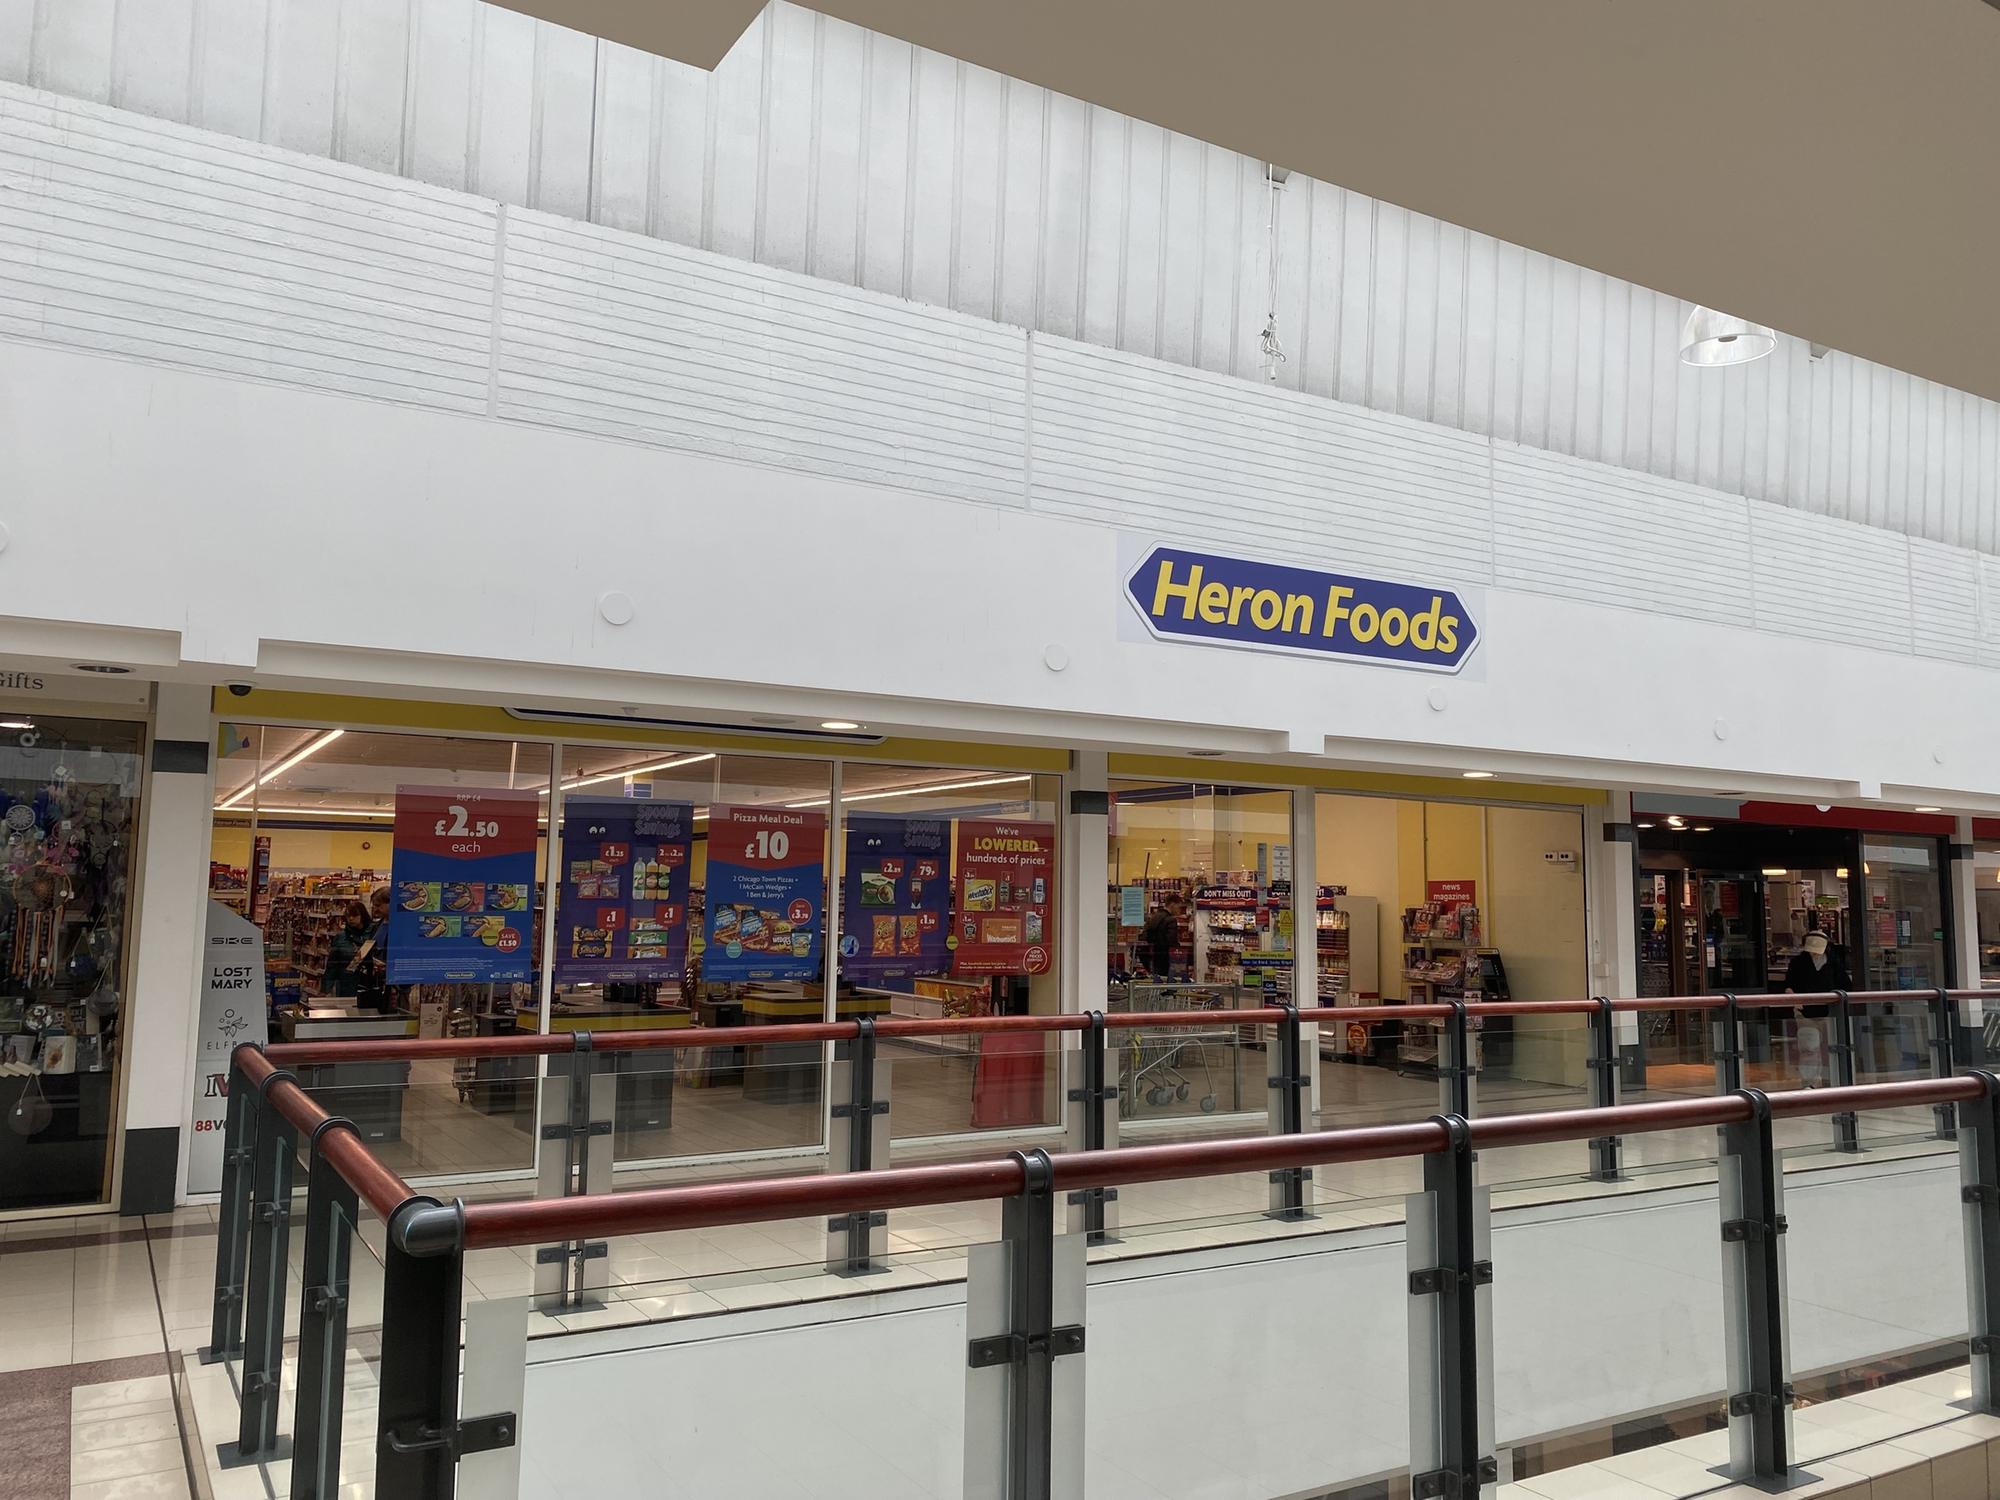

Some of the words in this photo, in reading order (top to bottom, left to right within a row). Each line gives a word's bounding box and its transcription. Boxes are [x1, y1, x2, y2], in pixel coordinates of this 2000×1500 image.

[1151, 560, 1315, 634] Heron
[1322, 584, 1460, 653] Foods
[434, 805, 500, 838] £2.50
[733, 812, 757, 823] Pizza
[759, 814, 781, 825] Meal
[783, 815, 803, 825] Deal
[995, 826, 1020, 836] We've
[451, 840, 481, 853] each
[744, 830, 790, 861] £10
[974, 837, 1040, 853] LOWERED
[966, 852, 1008, 864] hundreds
[1009, 853, 1020, 864] of
[1020, 855, 1046, 867] prices
[1203, 889, 1221, 898] DON'T
[1222, 889, 1236, 898] MISS
[1236, 889, 1252, 898] OUT!
[1442, 883, 1461, 891] news
[1433, 892, 1470, 902] magazines
[213, 967, 253, 978] LOST
[211, 979, 253, 990] MARY
